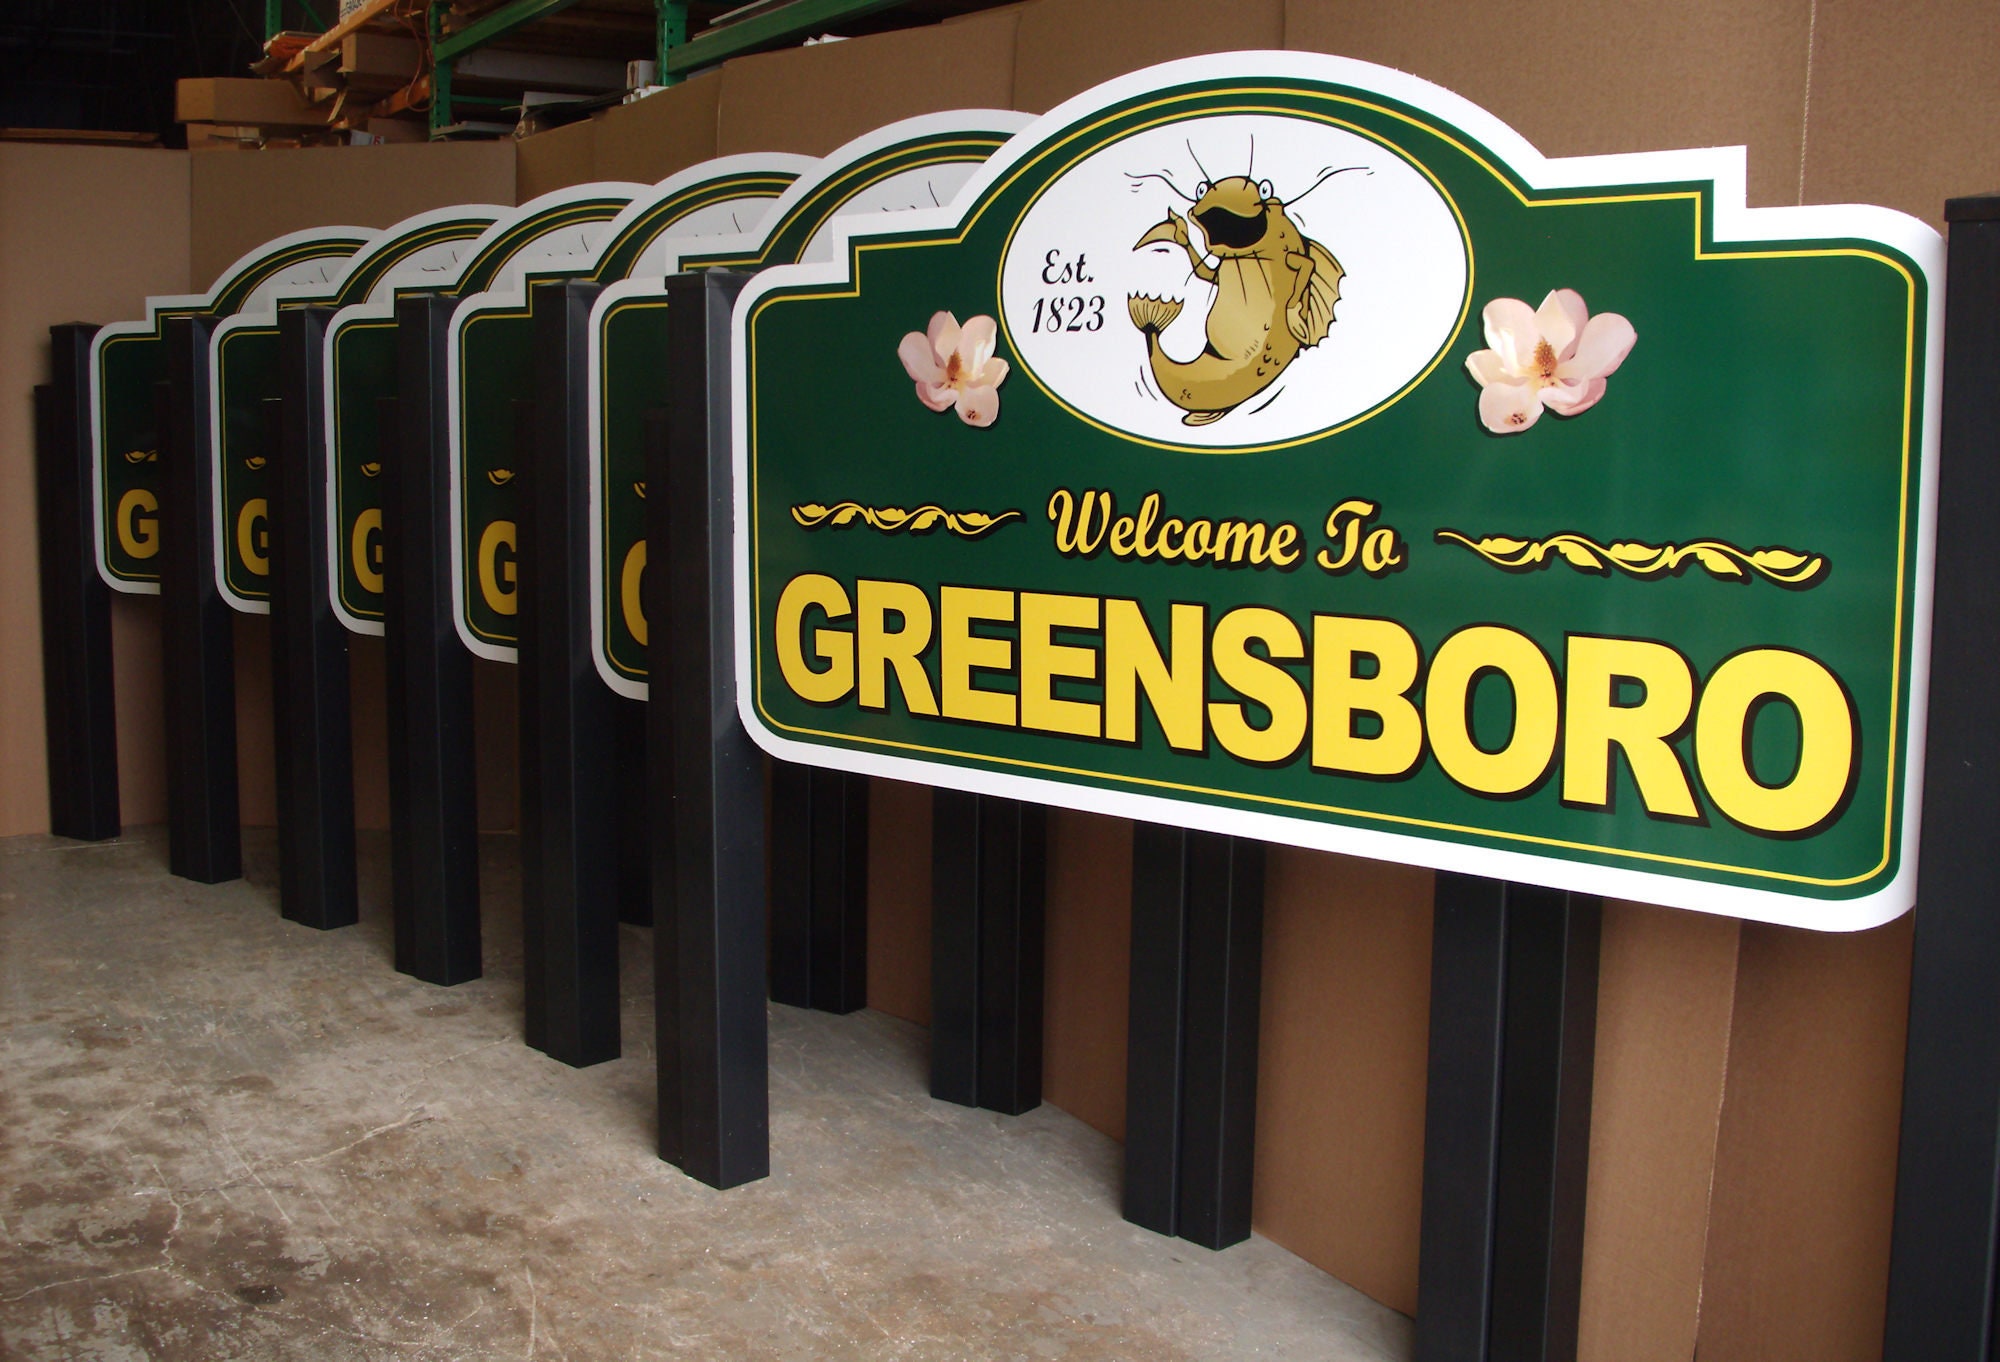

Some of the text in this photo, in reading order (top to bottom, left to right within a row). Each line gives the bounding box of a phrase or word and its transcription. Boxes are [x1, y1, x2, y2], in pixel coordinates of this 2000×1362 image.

[1041, 249, 1095, 284] Est.
[1032, 295, 1106, 334] 1823
[1047, 488, 1404, 575] Welcome To
[774, 573, 1856, 834] GREENSBORO
